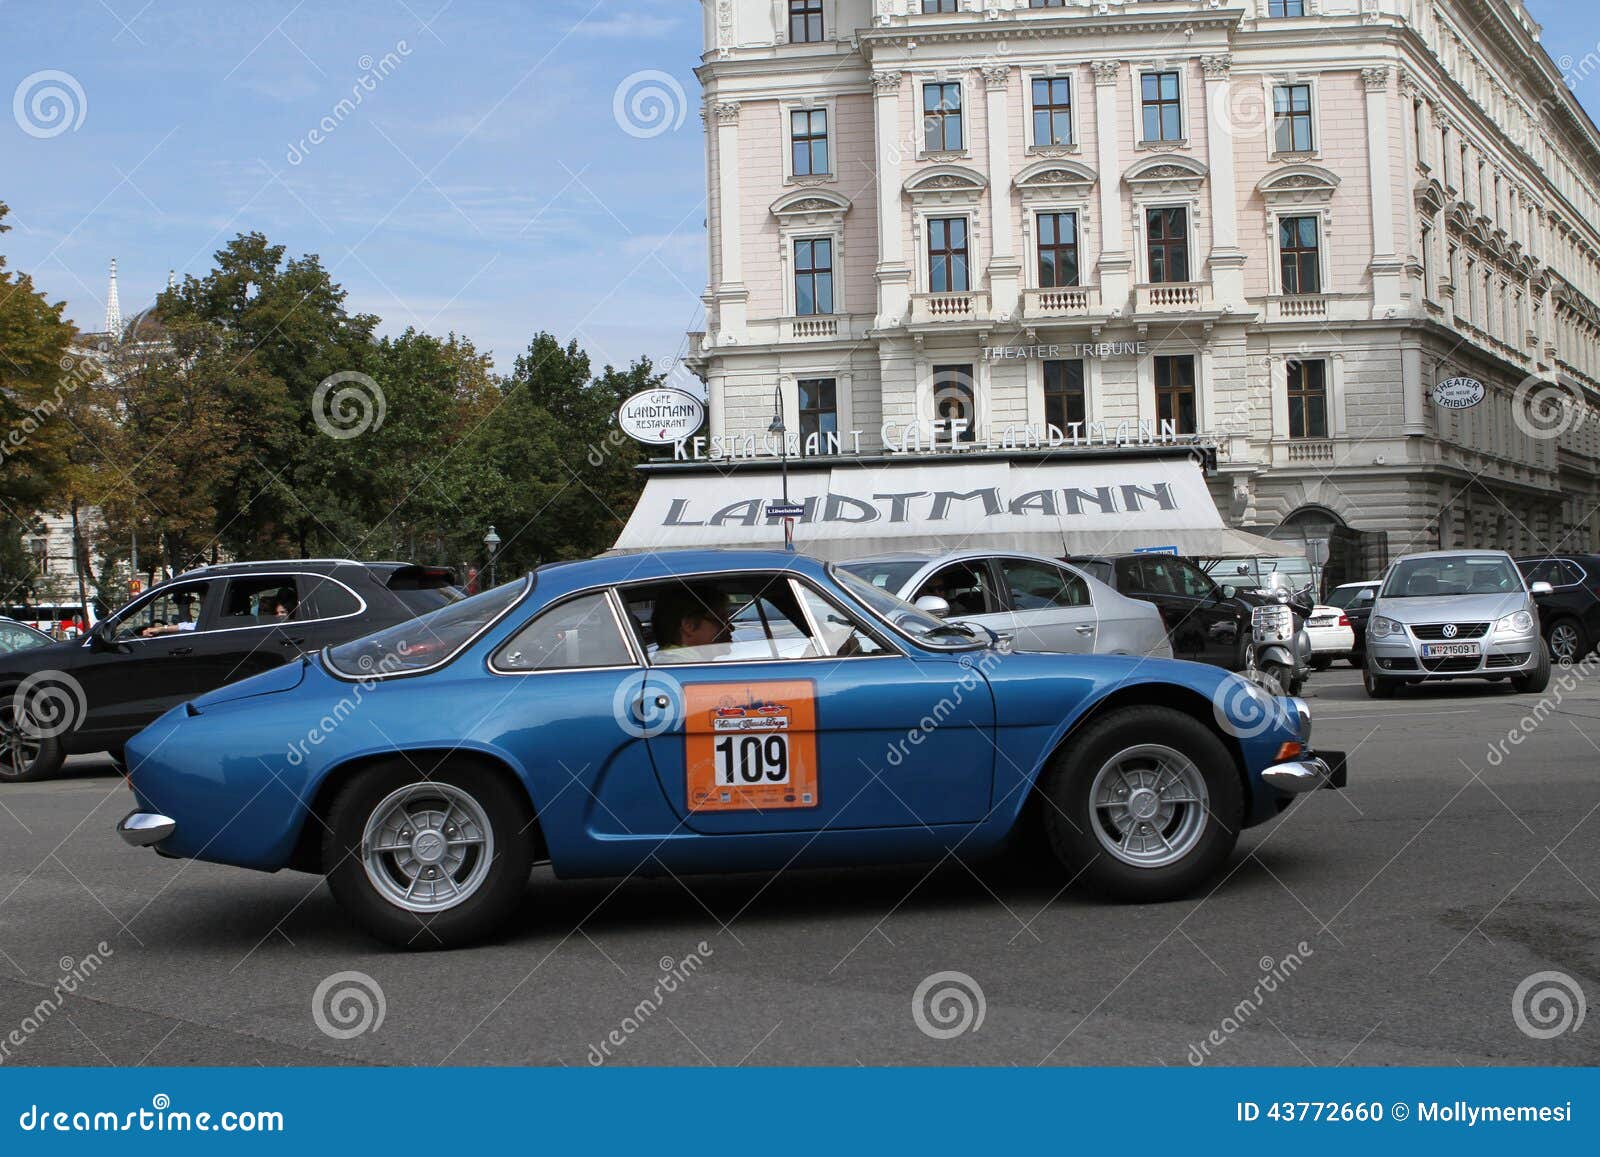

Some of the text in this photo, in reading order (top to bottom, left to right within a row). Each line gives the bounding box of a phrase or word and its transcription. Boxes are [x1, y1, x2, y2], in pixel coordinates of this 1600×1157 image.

[982, 345, 1060, 360] THEATER
[1434, 379, 1480, 393] THEATER
[627, 405, 695, 419] LANDTMANN
[636, 419, 687, 429] RESTAURANT
[673, 418, 1178, 461] RESTAURANT CAFE LANDTMANN
[661, 482, 1179, 527] LANDTMANN
[716, 735, 787, 783] 109
